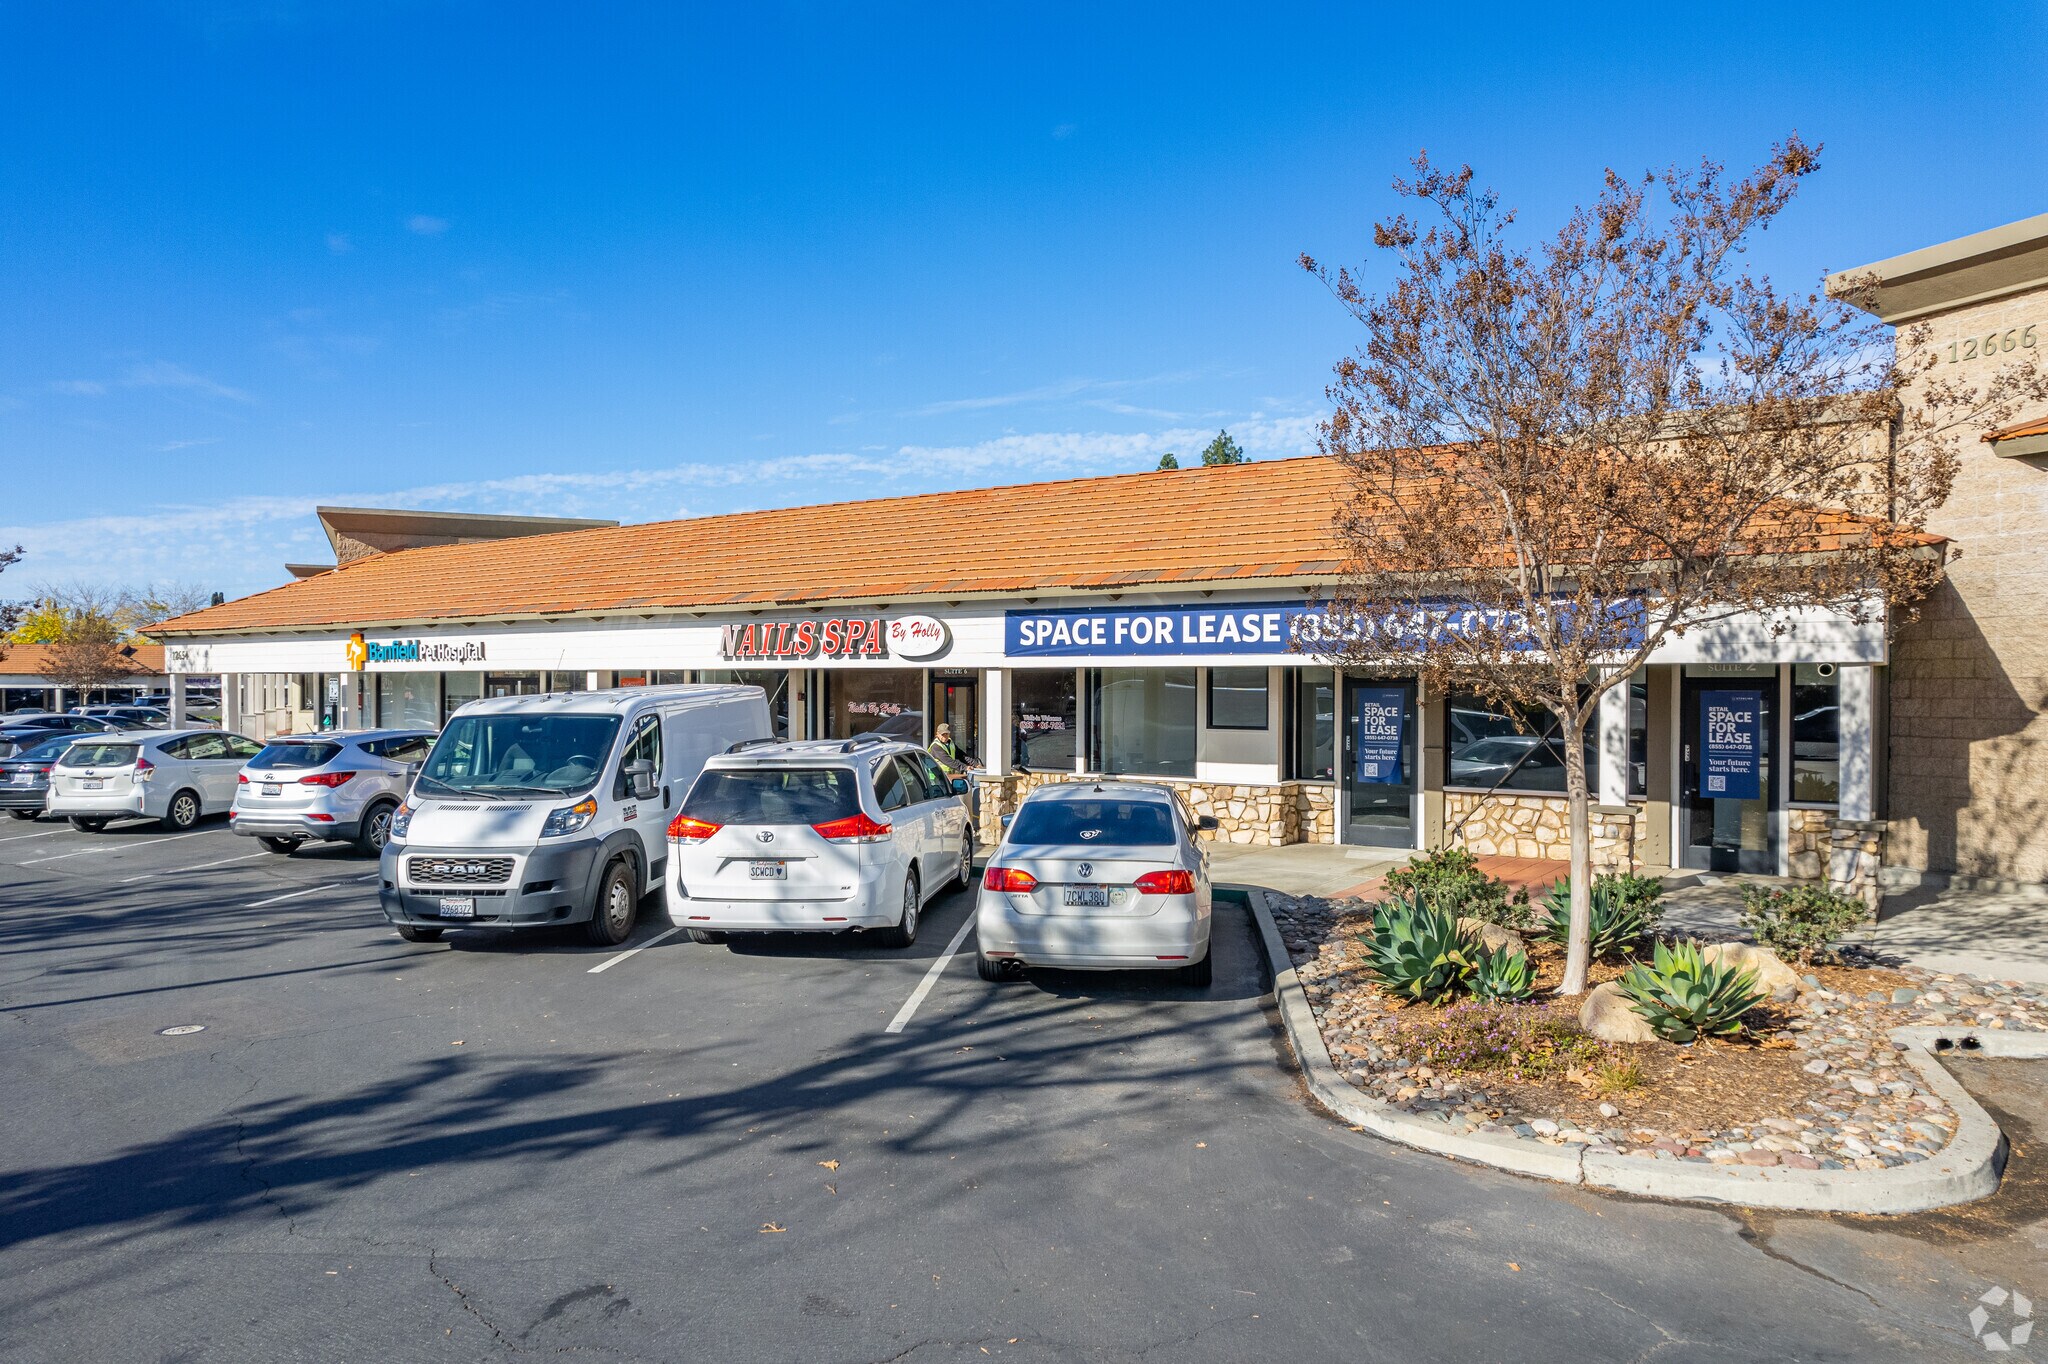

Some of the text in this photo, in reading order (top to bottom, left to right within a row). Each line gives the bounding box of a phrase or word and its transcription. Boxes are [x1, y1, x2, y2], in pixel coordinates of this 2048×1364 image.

[1947, 324, 2037, 364] 12666
[891, 621, 943, 640] By Holly
[1019, 617, 1107, 646] SPACE
[1114, 616, 1174, 645] FOR
[1182, 613, 1281, 643] LEASE
[717, 618, 883, 657] NAILS SPA
[368, 639, 485, 664] Banfield Pet Hospital
[1708, 663, 1742, 672] SUITE
[1364, 707, 1398, 717] SPACE
[1708, 712, 1752, 723] SPACE
[1364, 716, 1386, 726] FOR
[1364, 725, 1398, 735] LEASE
[1708, 722, 1736, 733] FOR
[1708, 732, 1751, 744] LEASE
[1727, 758, 1751, 767] future
[1708, 765, 1730, 773] starts
[433, 865, 486, 874] RAM
[750, 867, 774, 877] SCWCD
[1066, 890, 1105, 902] 7CWL380
